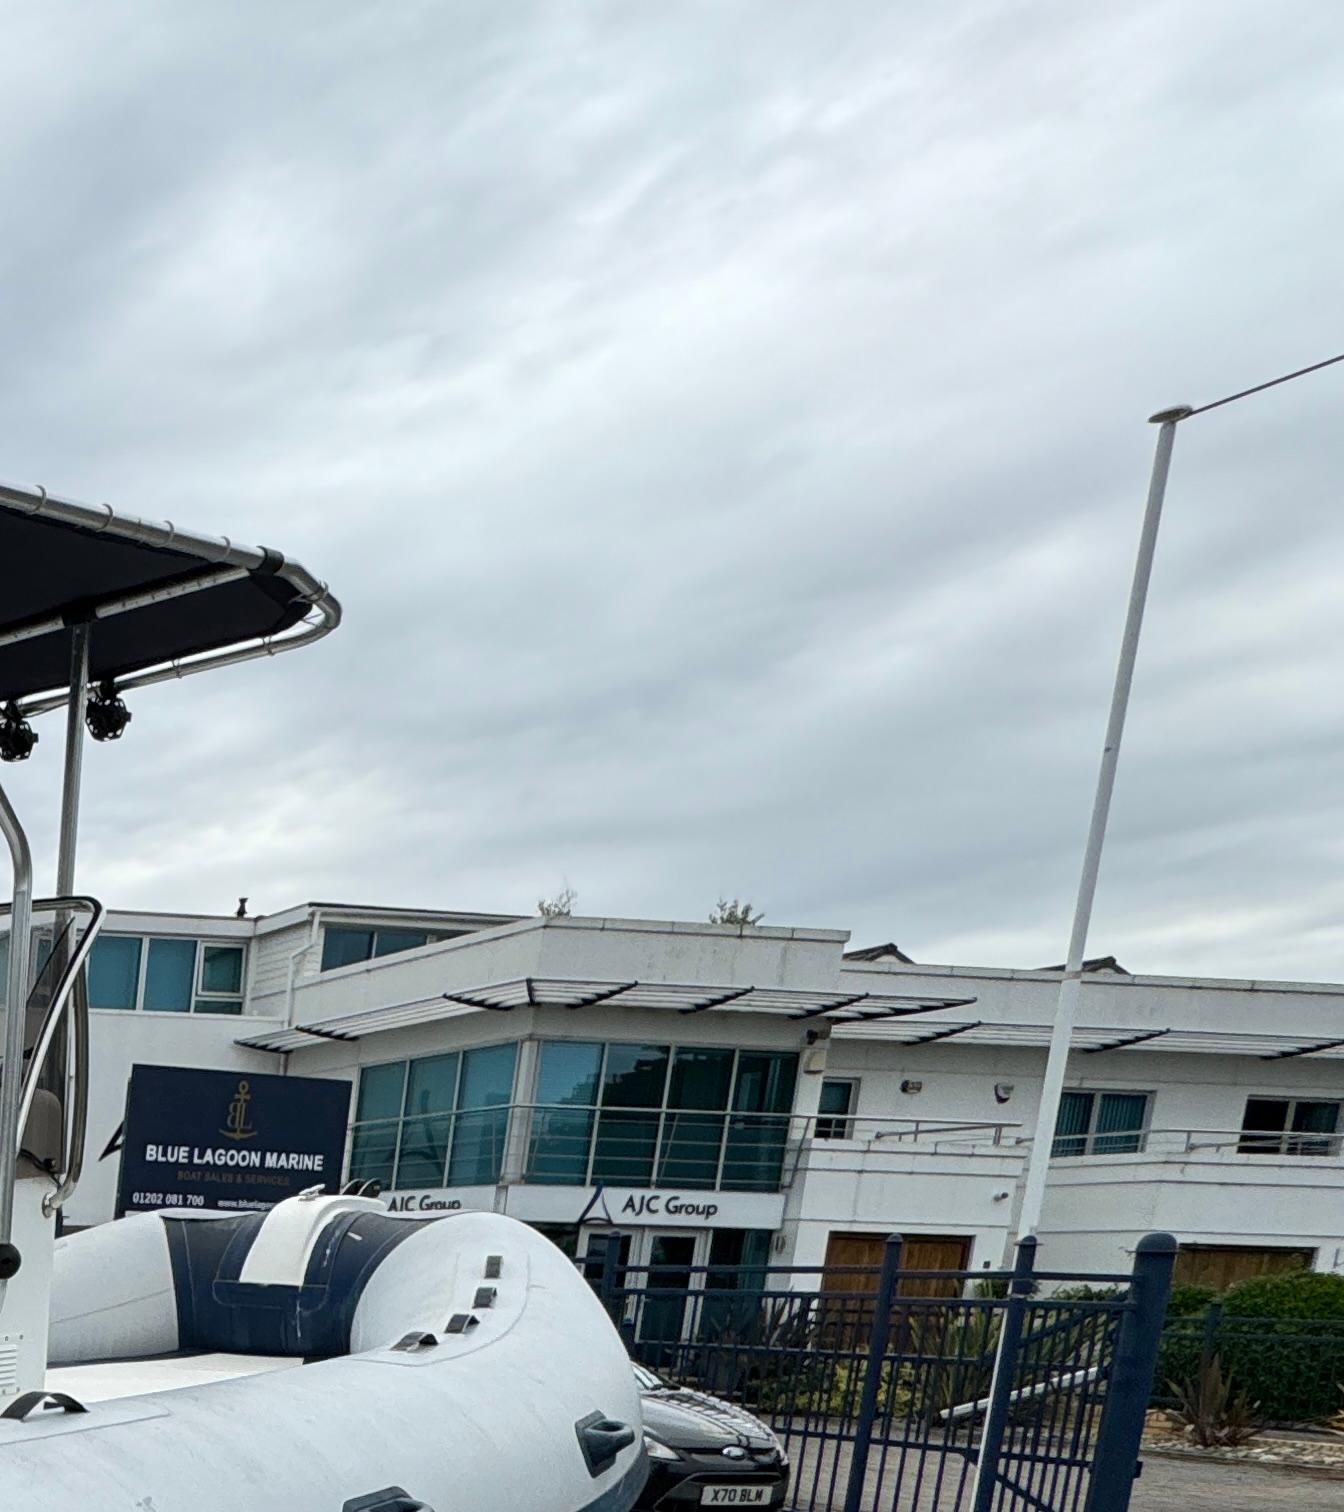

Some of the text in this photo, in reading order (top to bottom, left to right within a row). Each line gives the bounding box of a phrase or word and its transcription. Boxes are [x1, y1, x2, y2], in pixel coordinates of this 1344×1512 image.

[145, 1144, 324, 1172] BLUE LAGOON MARINE
[176, 1169, 202, 1181] BOAT
[204, 1171, 235, 1184] SALES
[243, 1173, 291, 1186] SERVICES
[132, 1192, 163, 1205] 01202
[186, 1194, 205, 1207] 700
[622, 1195, 718, 1220] AJC Group
[711, 1488, 764, 1503] X70 BLM
